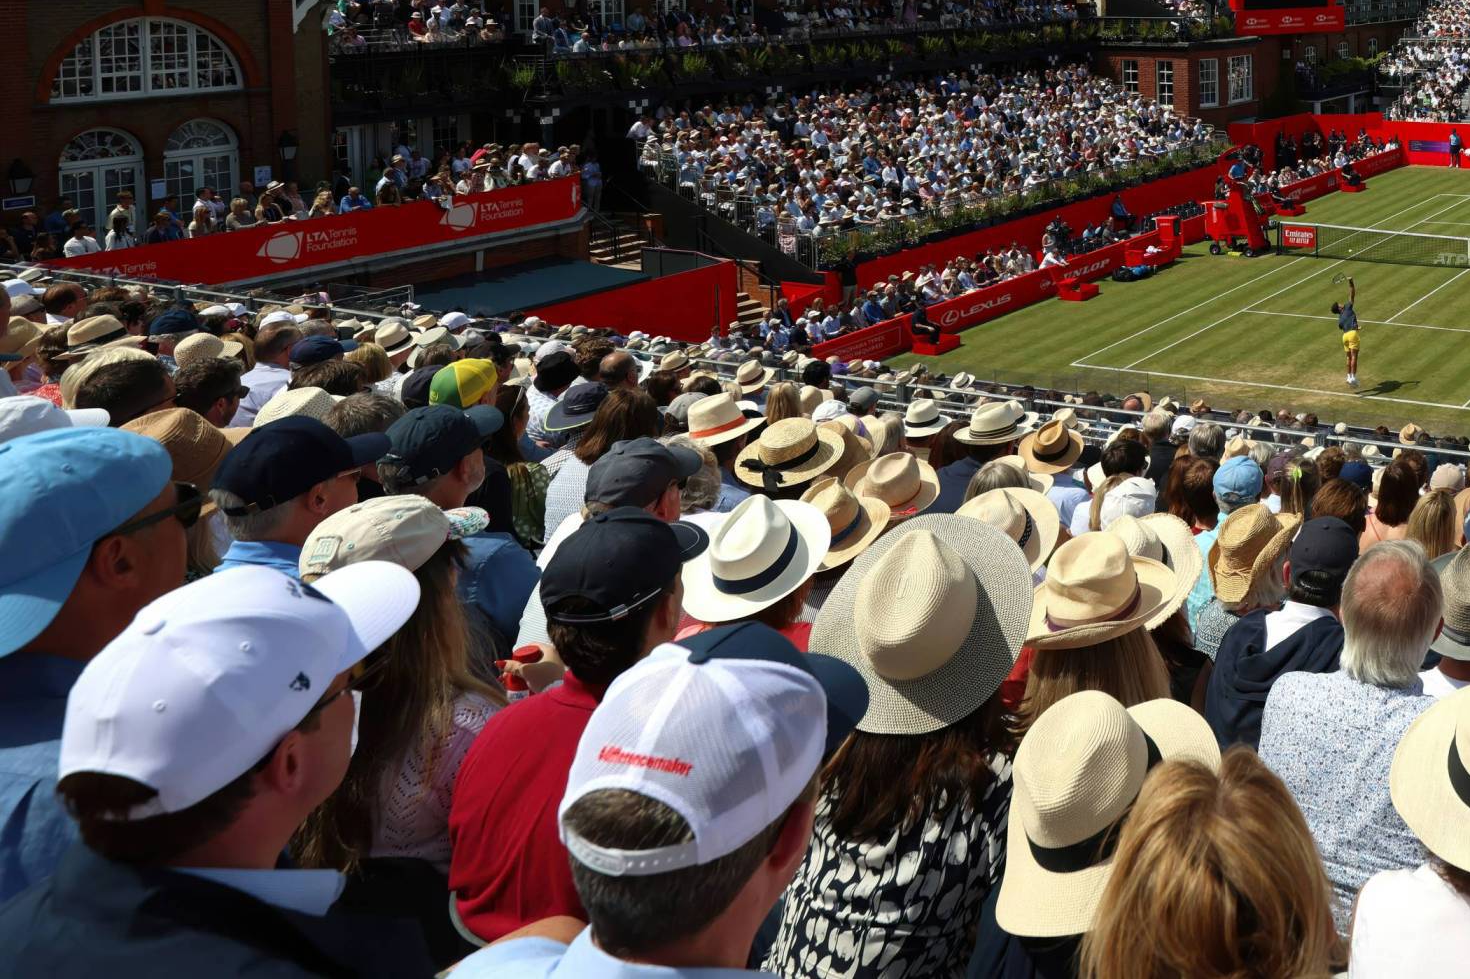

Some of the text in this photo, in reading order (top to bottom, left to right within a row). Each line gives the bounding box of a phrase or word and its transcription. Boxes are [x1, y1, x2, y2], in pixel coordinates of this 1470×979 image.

[481, 198, 524, 212] LTA Tennis
[480, 207, 524, 221] Foundation
[306, 227, 357, 242] LTA Tennis
[1285, 230, 1313, 239] Emirates
[306, 236, 358, 252] Foundation
[1433, 252, 1468, 266] ATP
[961, 294, 1011, 317] LEXUS
